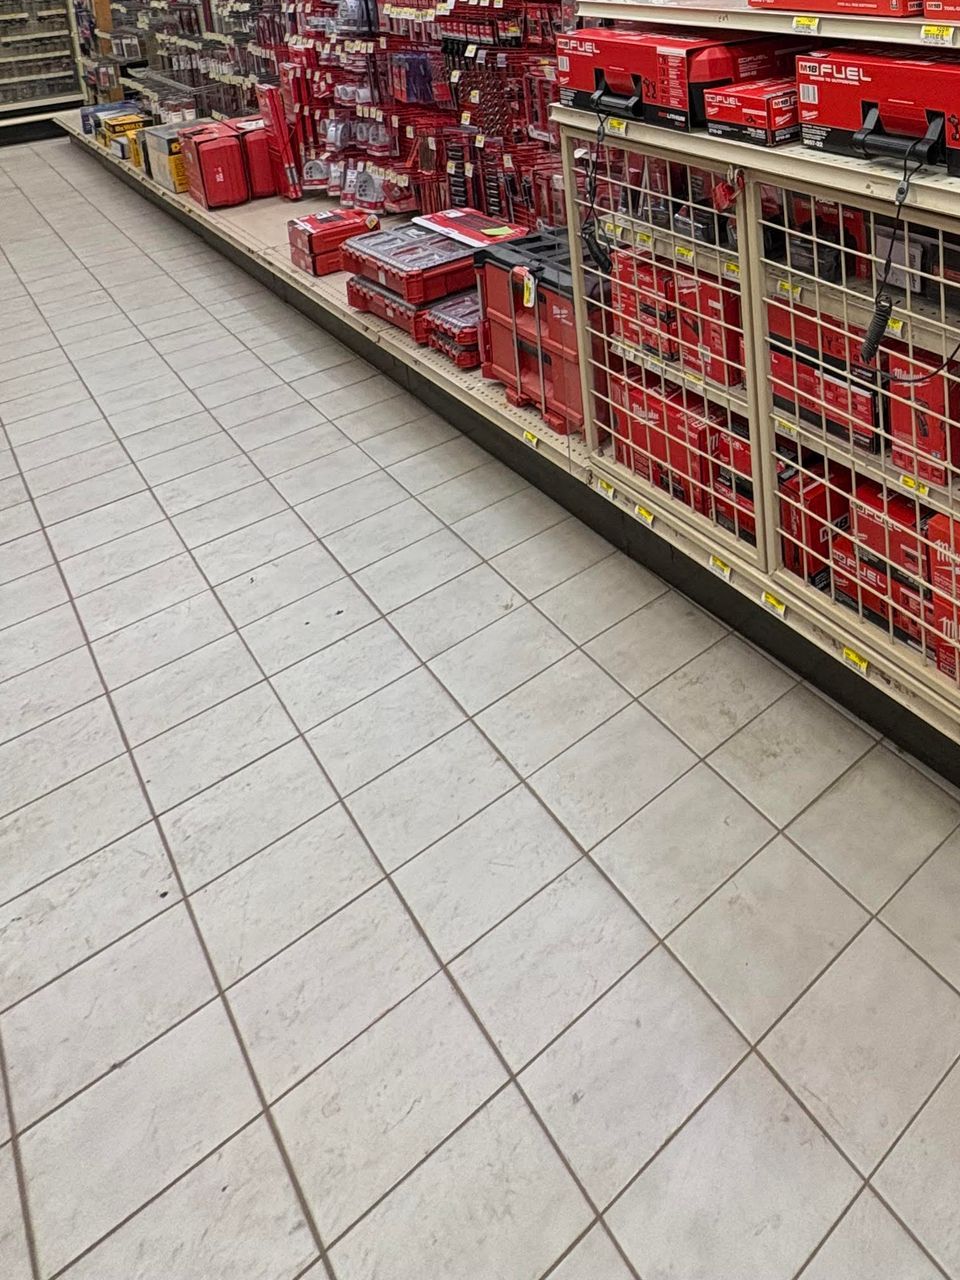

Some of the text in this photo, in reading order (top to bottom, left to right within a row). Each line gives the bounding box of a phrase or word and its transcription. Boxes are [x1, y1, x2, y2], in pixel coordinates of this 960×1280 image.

[570, 40, 600, 53] FUEL
[800, 62, 872, 81] M18 FUEL
[717, 96, 742, 106] FUEL
